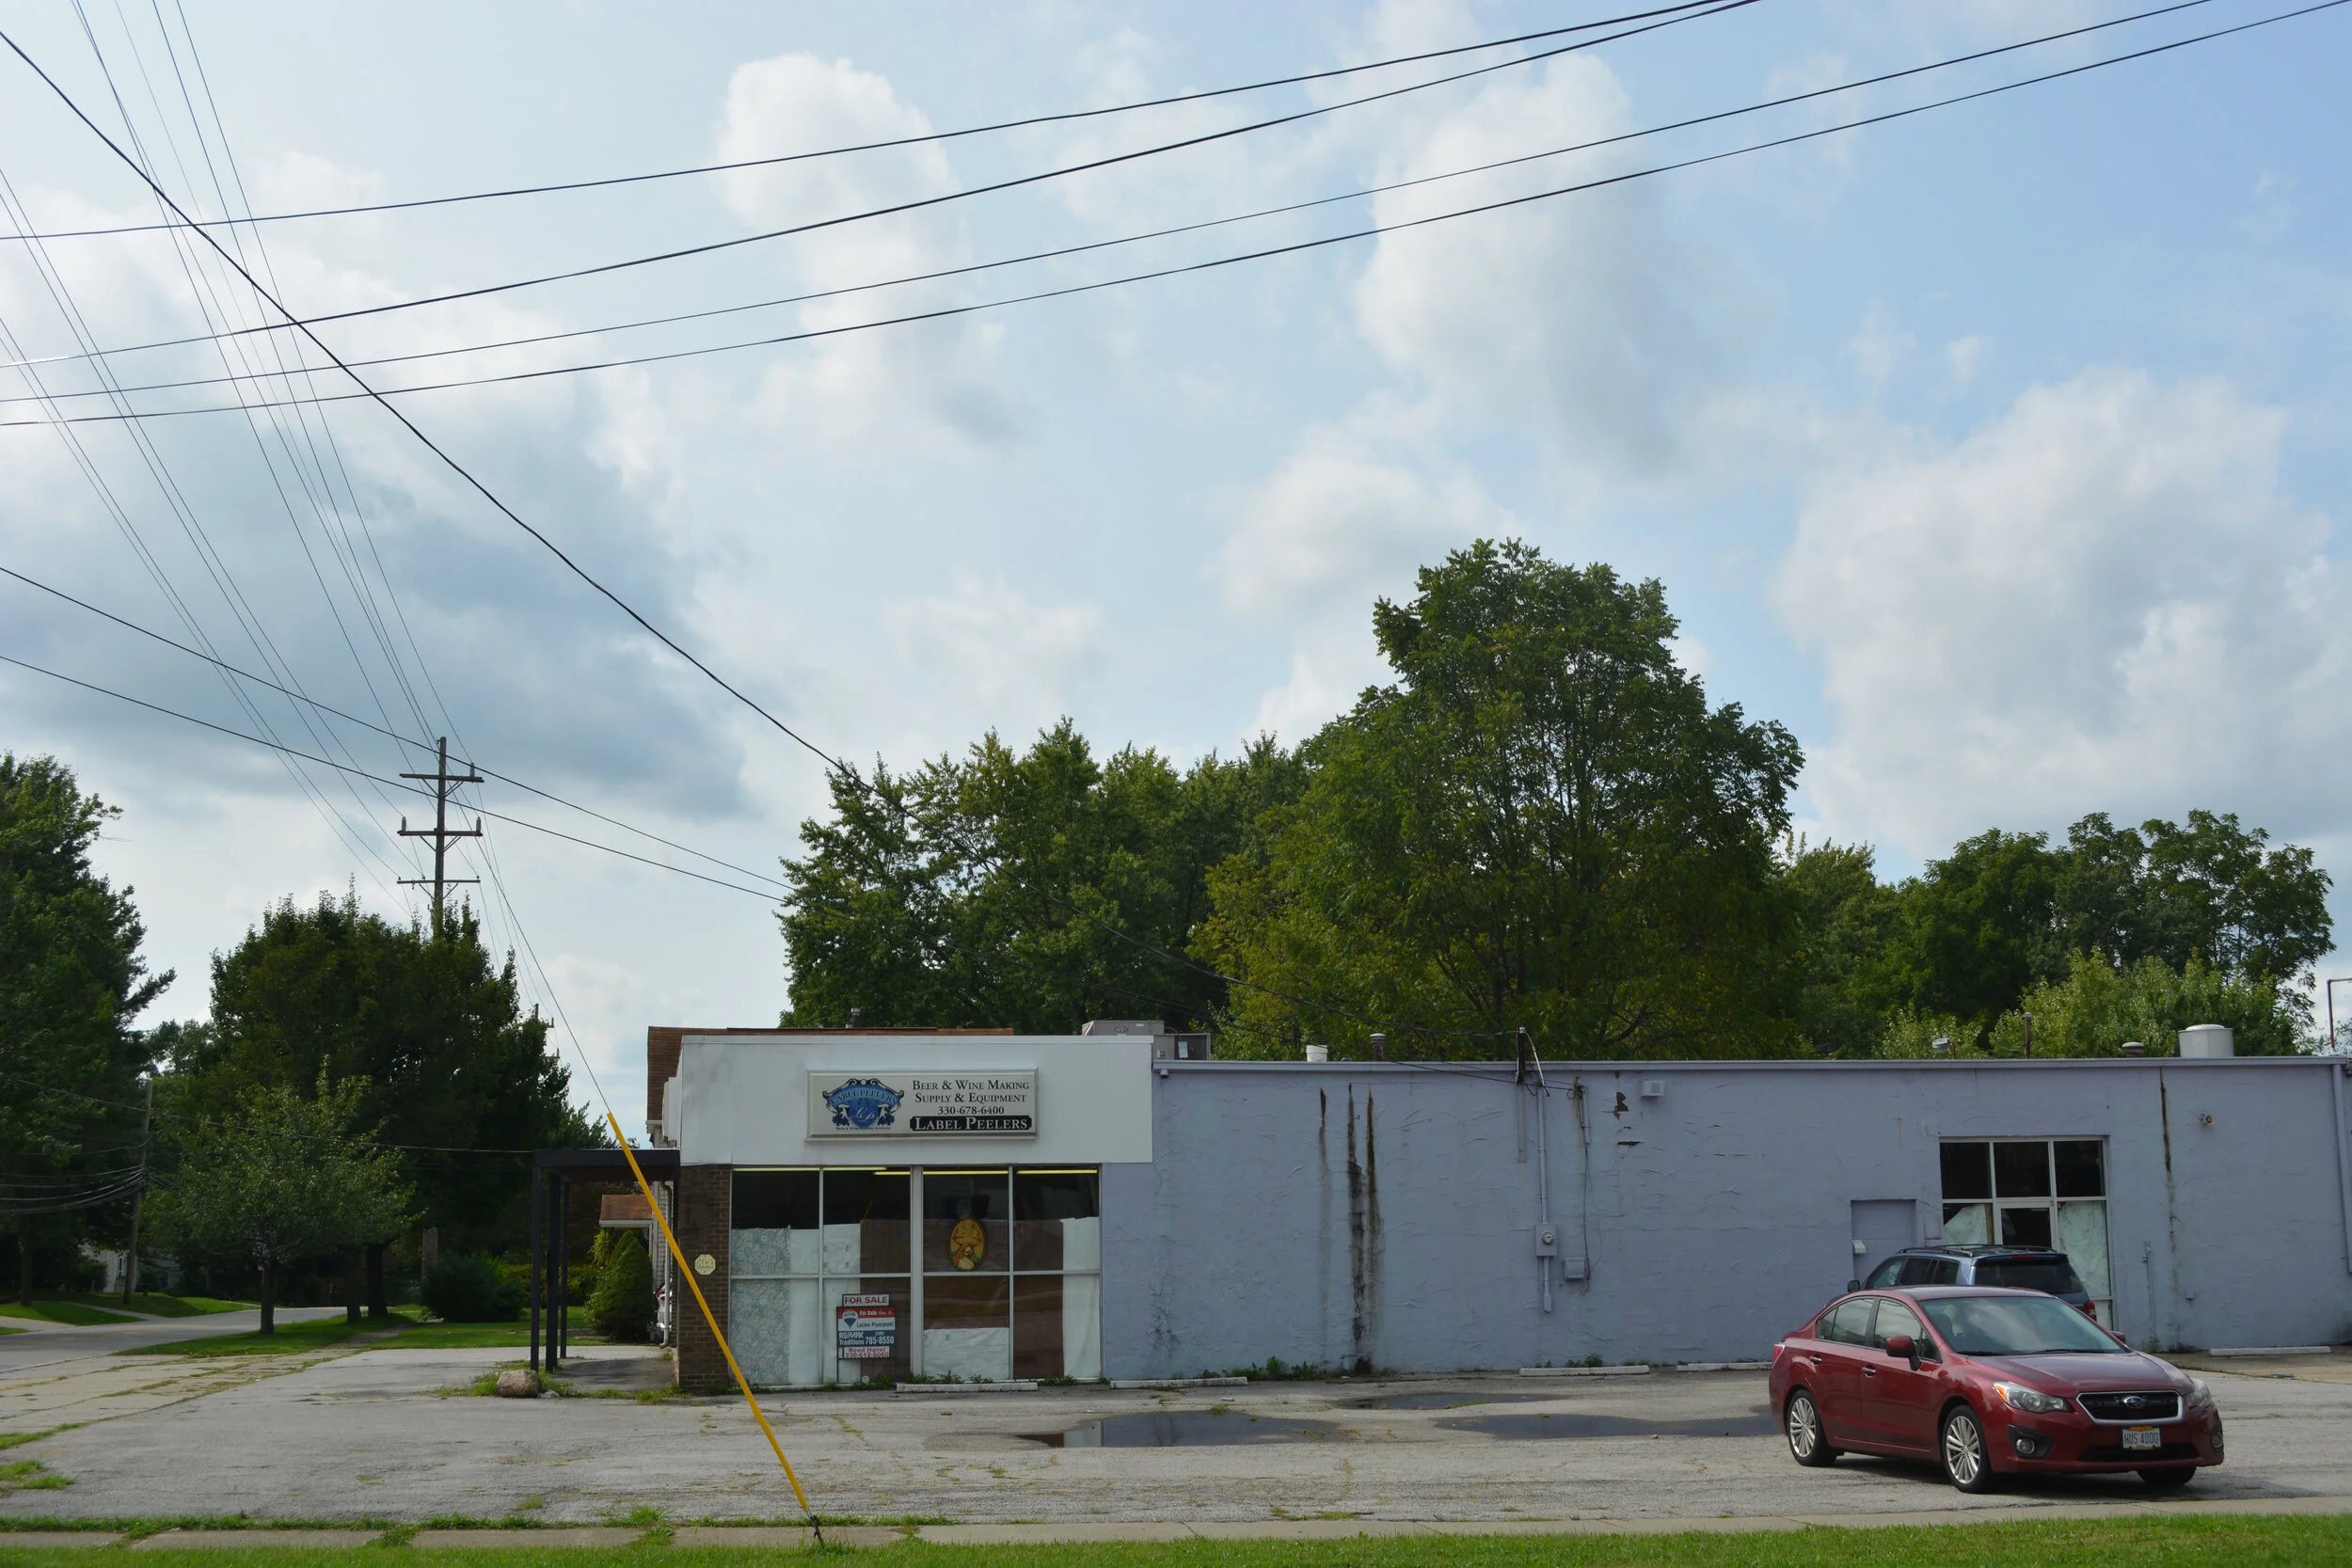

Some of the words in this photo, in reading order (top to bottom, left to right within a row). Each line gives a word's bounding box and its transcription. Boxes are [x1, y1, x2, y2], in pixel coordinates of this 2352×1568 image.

[913, 1080, 938, 1090] BEER
[942, 1080, 952, 1090] &
[955, 1080, 984, 1090] WINE
[988, 1079, 1029, 1090] MAKING
[914, 1092, 951, 1103] SUPPLY
[954, 1092, 965, 1103] &
[969, 1092, 1027, 1104] EQUIPMENT
[937, 1105, 1005, 1116] 330-678-6400
[915, 1117, 961, 1130] LABEL
[965, 1117, 1027, 1130] PEELERS
[865, 1336, 895, 1345] 785-8550
